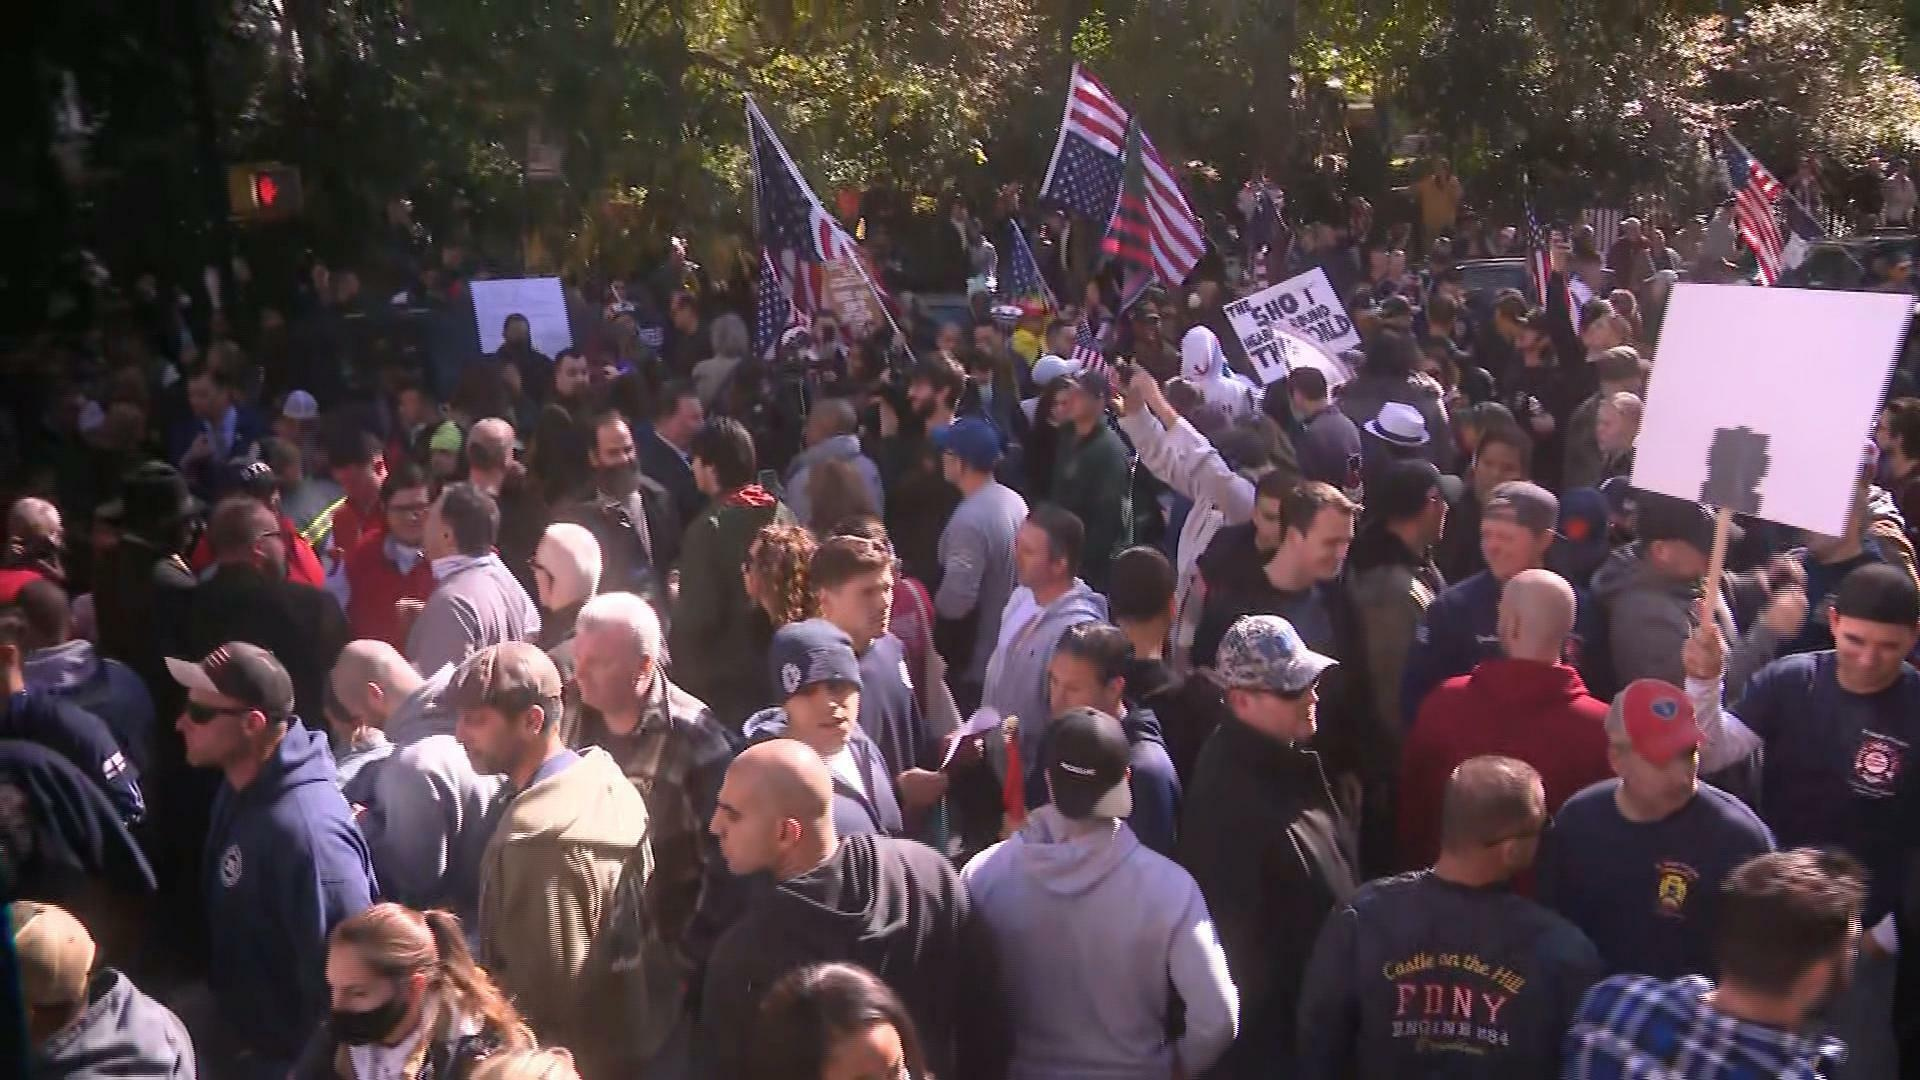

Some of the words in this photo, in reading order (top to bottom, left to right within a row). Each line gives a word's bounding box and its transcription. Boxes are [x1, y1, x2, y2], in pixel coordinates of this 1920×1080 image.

[1226, 299, 1251, 317] THE
[1242, 325, 1275, 349] HEAR
[1288, 303, 1331, 328] ROUND
[1307, 313, 1351, 344] ORLD
[1382, 952, 1435, 981] Castle
[1438, 953, 1460, 968] on
[1462, 954, 1491, 977] the
[1490, 966, 1527, 995] Hill
[1396, 984, 1508, 1024] FDNY
[1391, 1020, 1473, 1039] ENGINE
